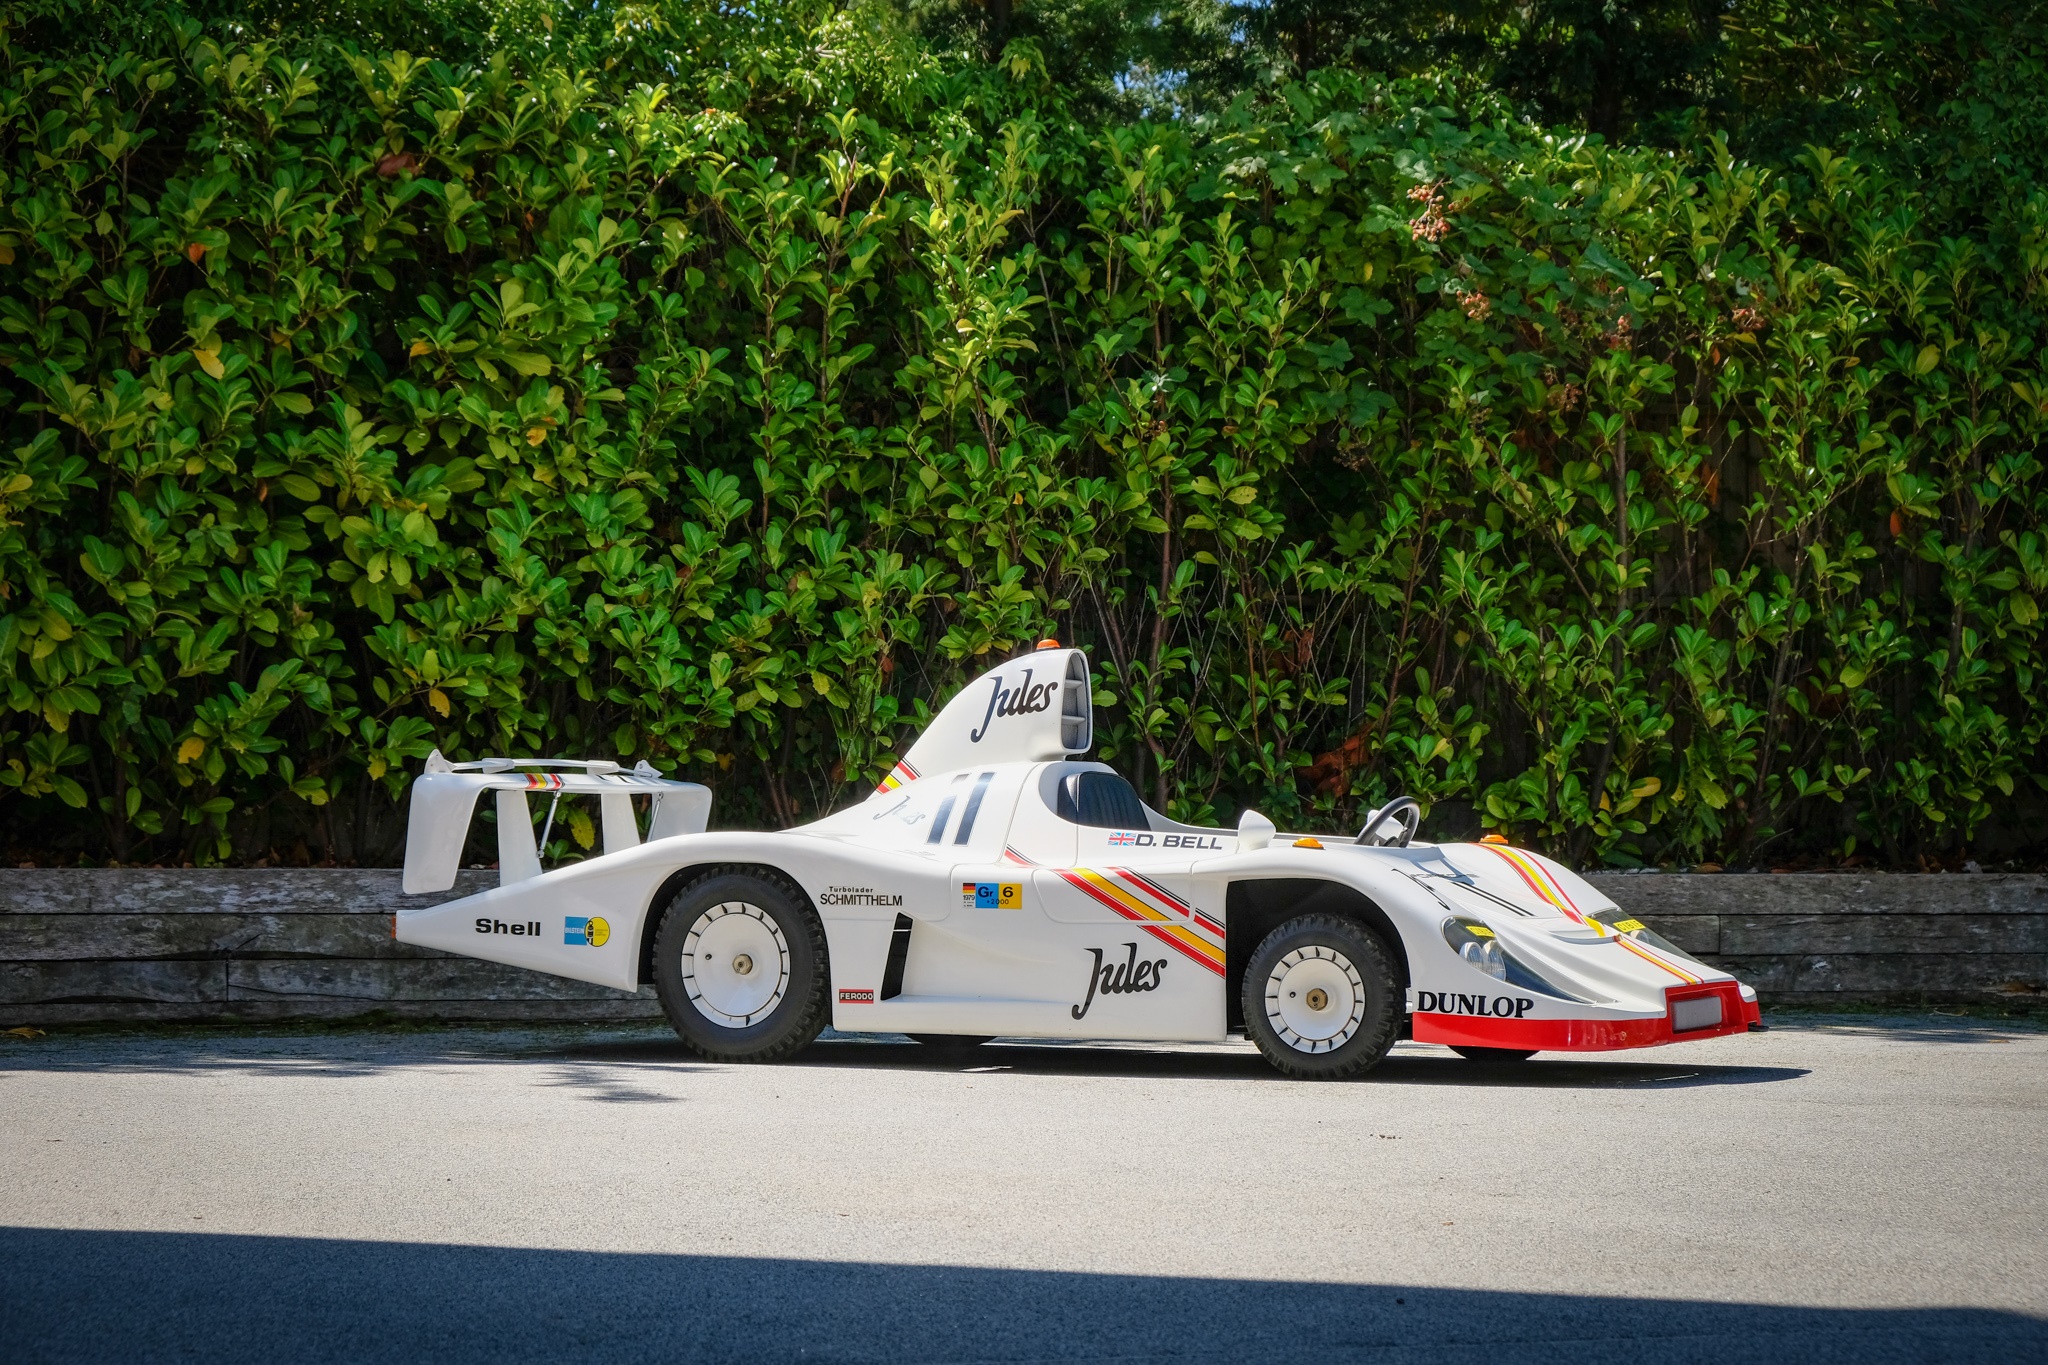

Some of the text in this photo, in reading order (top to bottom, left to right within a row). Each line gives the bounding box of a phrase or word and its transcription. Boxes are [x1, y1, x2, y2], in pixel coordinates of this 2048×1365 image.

[970, 667, 1058, 743] Jules
[1134, 833, 1223, 850] D. BELL
[819, 893, 903, 906] SCHMITTHELM
[977, 886, 1014, 898] Gr 6
[475, 918, 541, 937] Shell
[1071, 942, 1168, 1020] Jules
[840, 992, 873, 1000] FERODO
[1417, 991, 1534, 1018] DUNLOP
